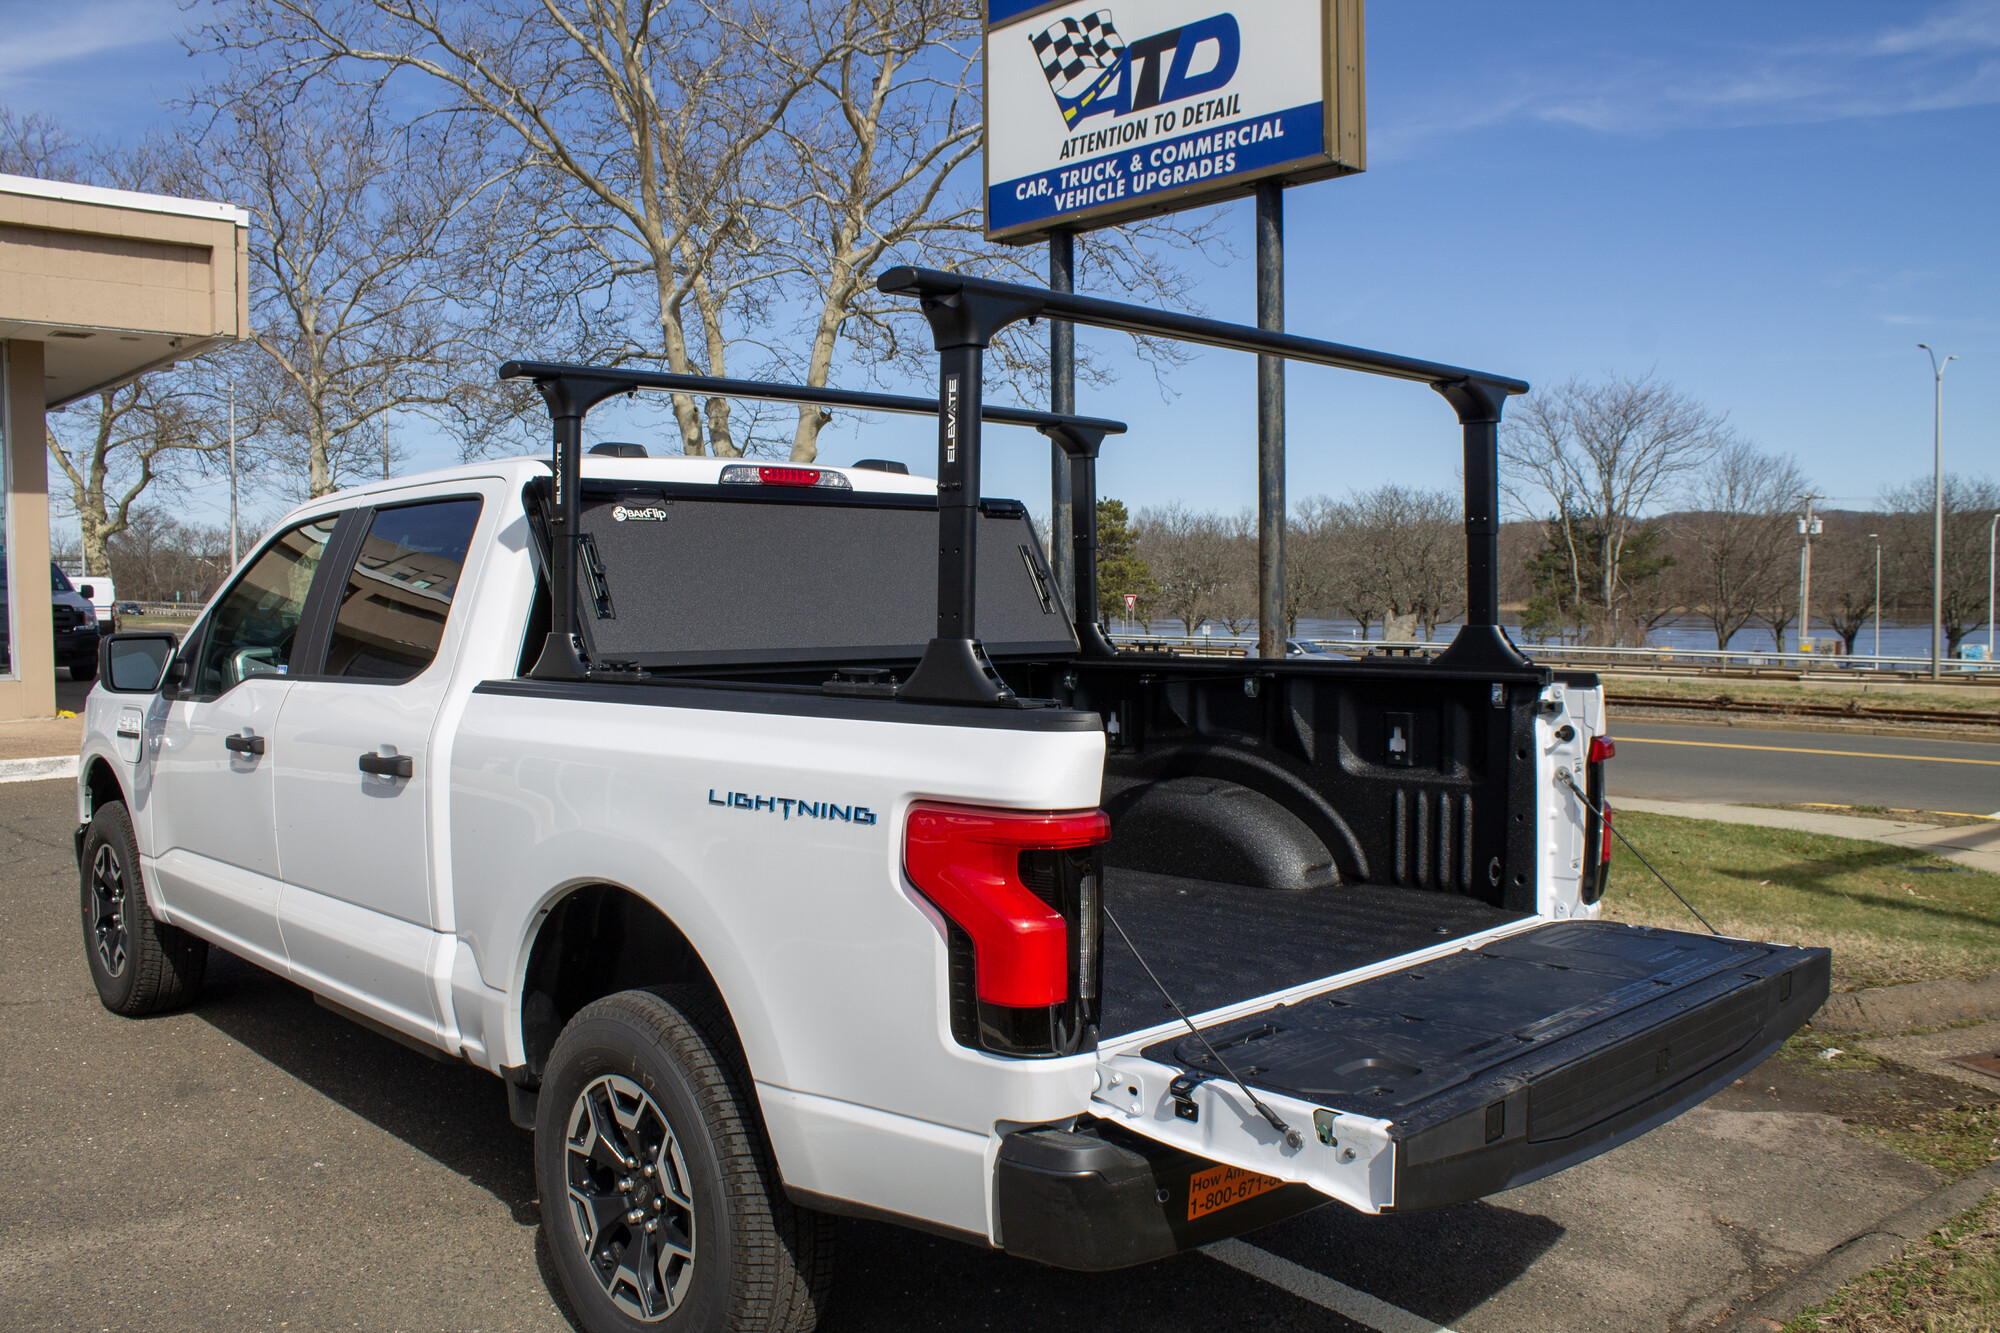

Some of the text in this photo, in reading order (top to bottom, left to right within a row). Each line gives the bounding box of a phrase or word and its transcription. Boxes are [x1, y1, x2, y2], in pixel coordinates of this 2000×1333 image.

[1056, 12, 1241, 131] ATD
[1059, 93, 1241, 160] ATTENTION TO DETAIL
[1016, 118, 1284, 200] CAR, TRUCK, & COMMERCIAL
[1054, 152, 1236, 211] VEHICLE UPGRADES
[946, 379, 957, 463] ELEVATE
[708, 789, 877, 824] LIGHTNING
[1191, 1176, 1283, 1215] 1-800-671-
[1192, 1174, 1221, 1194] How
